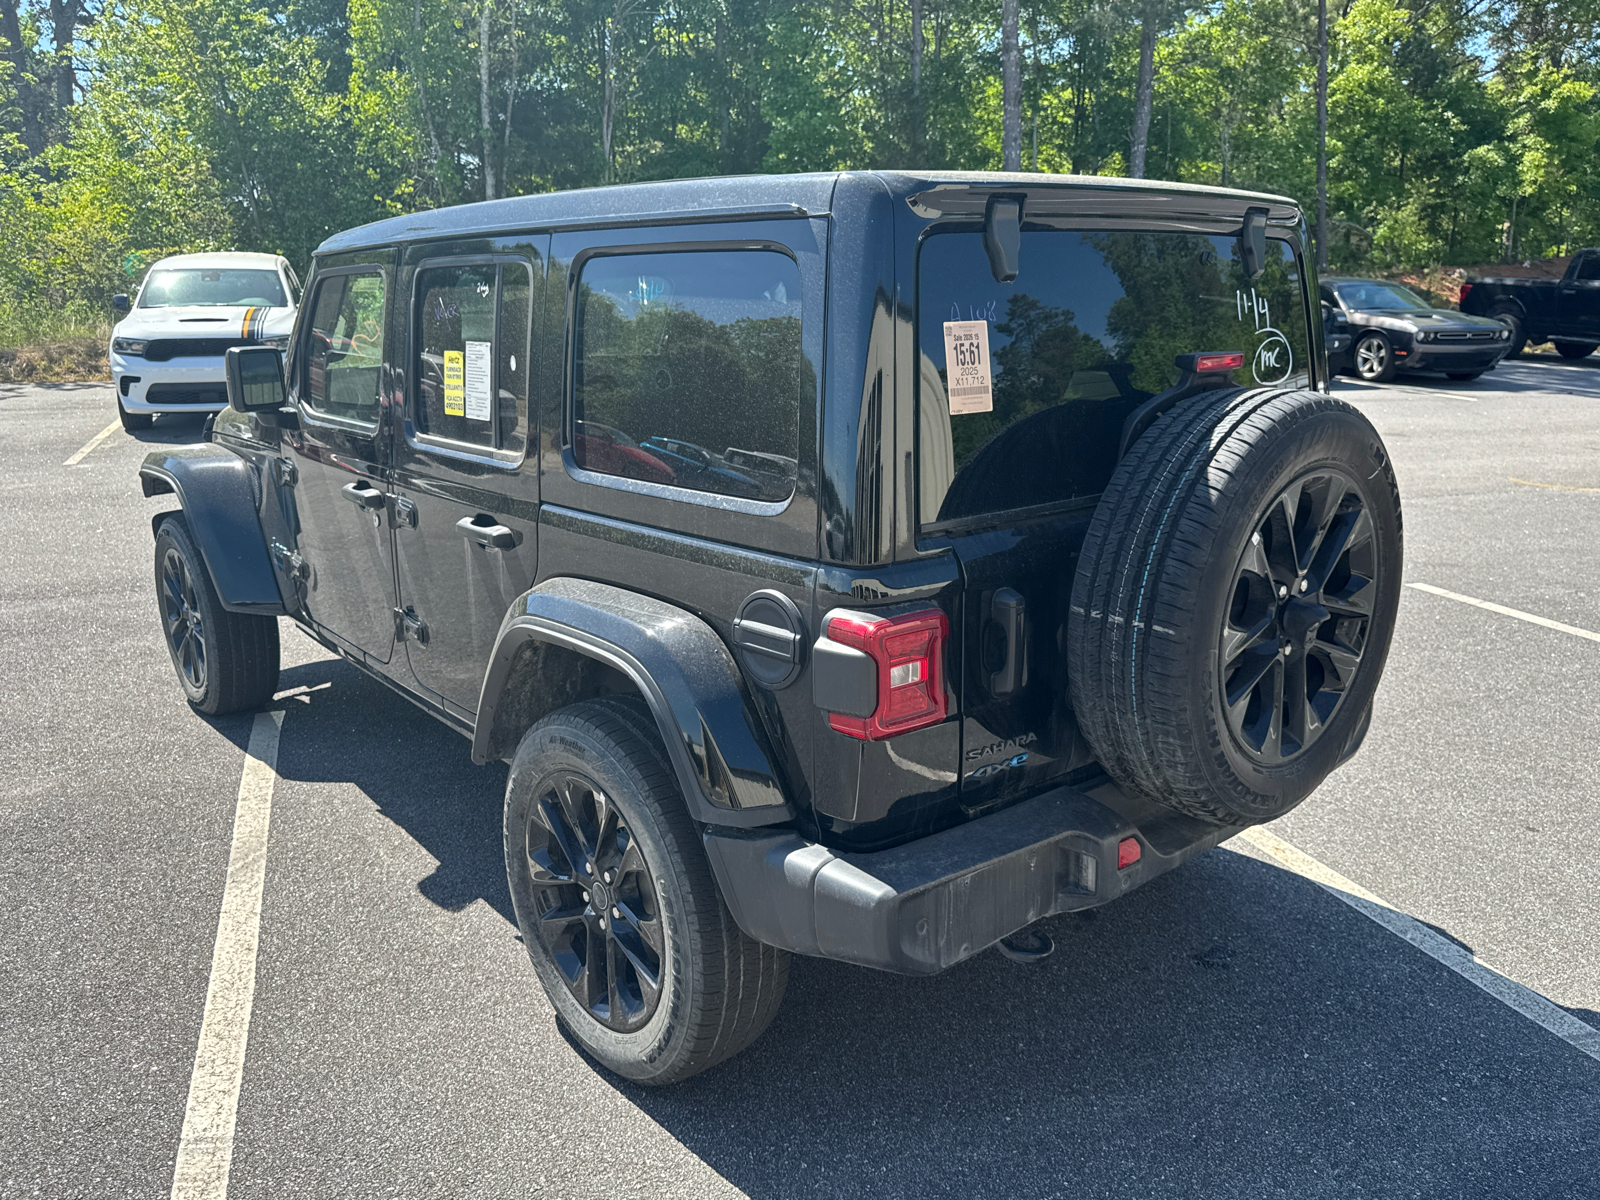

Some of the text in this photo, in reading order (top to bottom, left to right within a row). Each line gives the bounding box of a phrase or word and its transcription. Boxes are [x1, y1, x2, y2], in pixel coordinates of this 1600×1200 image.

[953, 334, 963, 342] Sale
[953, 341, 981, 366] 15:61
[448, 356, 460, 364] Hertz
[960, 366, 979, 376] 2025
[955, 376, 985, 387] X11,712
[966, 731, 1038, 762] SAHARA
